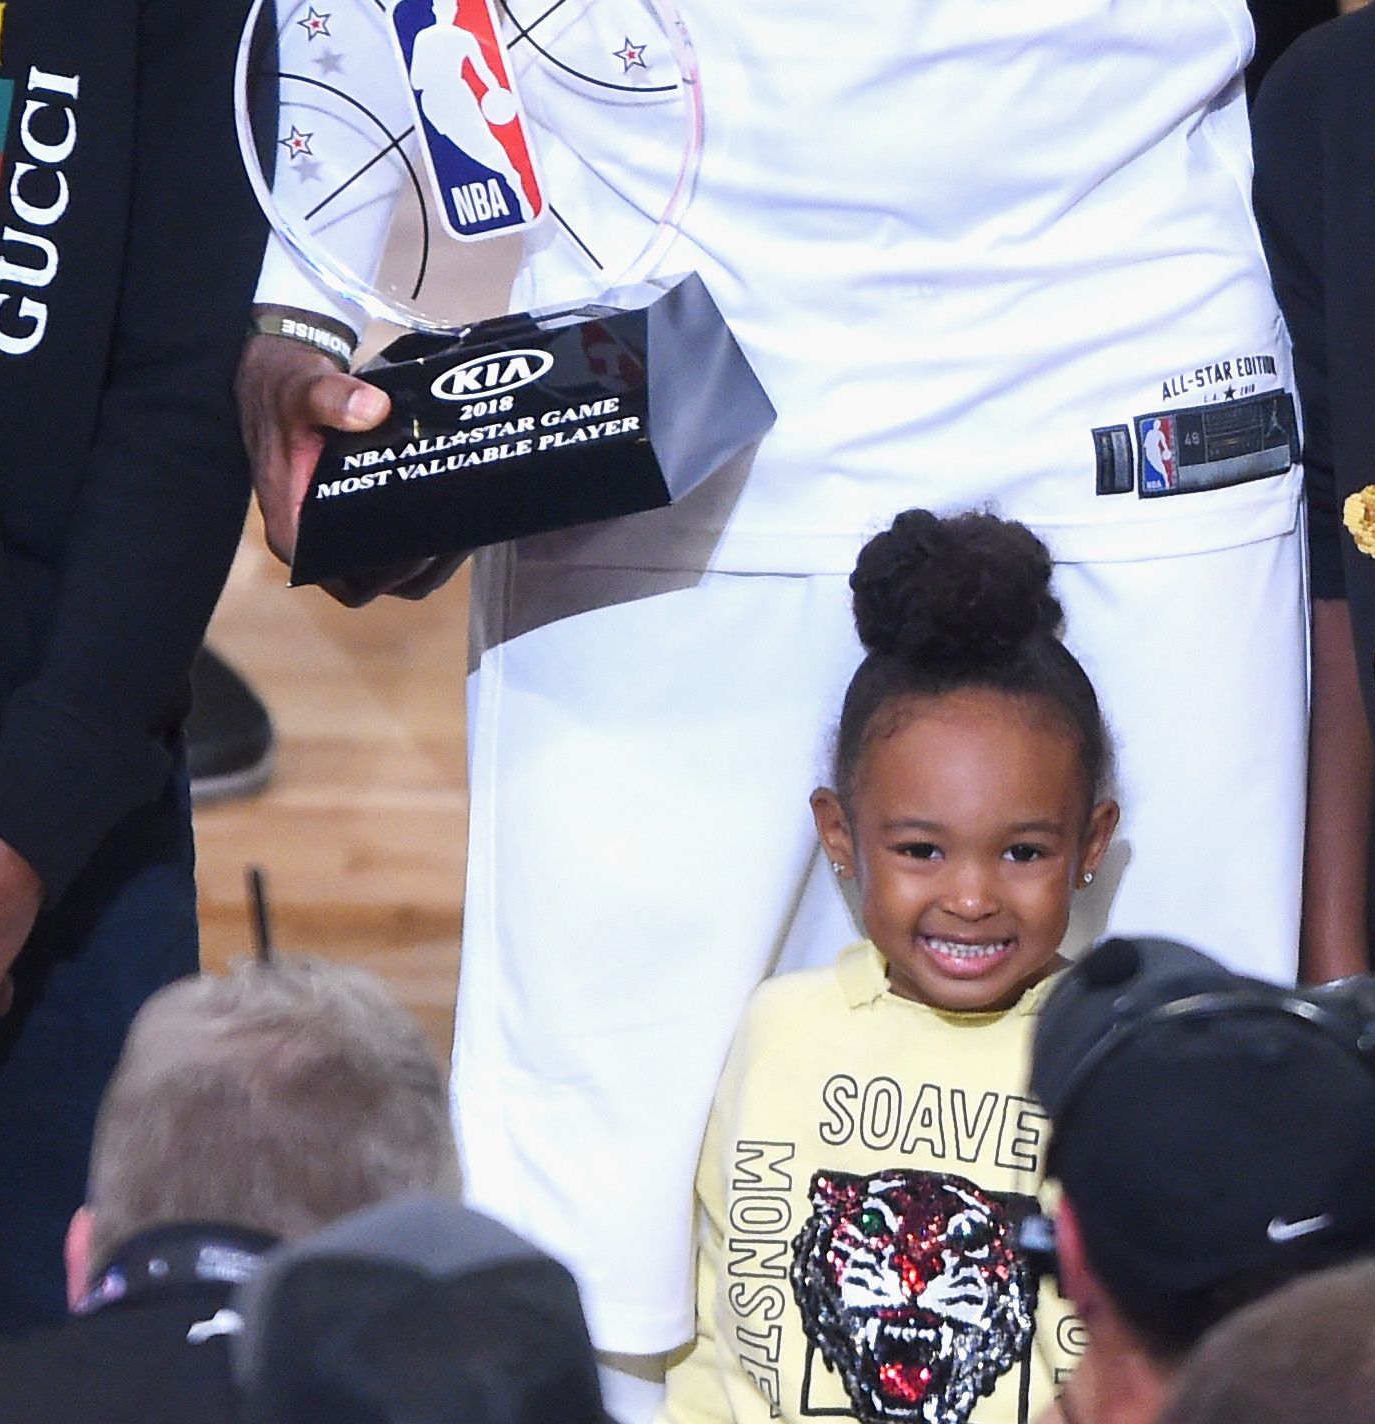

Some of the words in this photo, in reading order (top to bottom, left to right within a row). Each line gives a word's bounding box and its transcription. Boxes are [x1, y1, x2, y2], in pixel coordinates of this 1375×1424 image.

[450, 178, 510, 226] NBA
[451, 356, 533, 395] KIA
[1161, 360, 1233, 402] ALL-STAR
[459, 395, 514, 421] 2018
[315, 469, 393, 500] MOST
[396, 439, 533, 481] VALUABLE
[537, 416, 641, 451] PLAYER
[343, 449, 396, 471] NBA
[540, 397, 620, 427] GAME
[819, 1074, 1051, 1172] SOAVE
